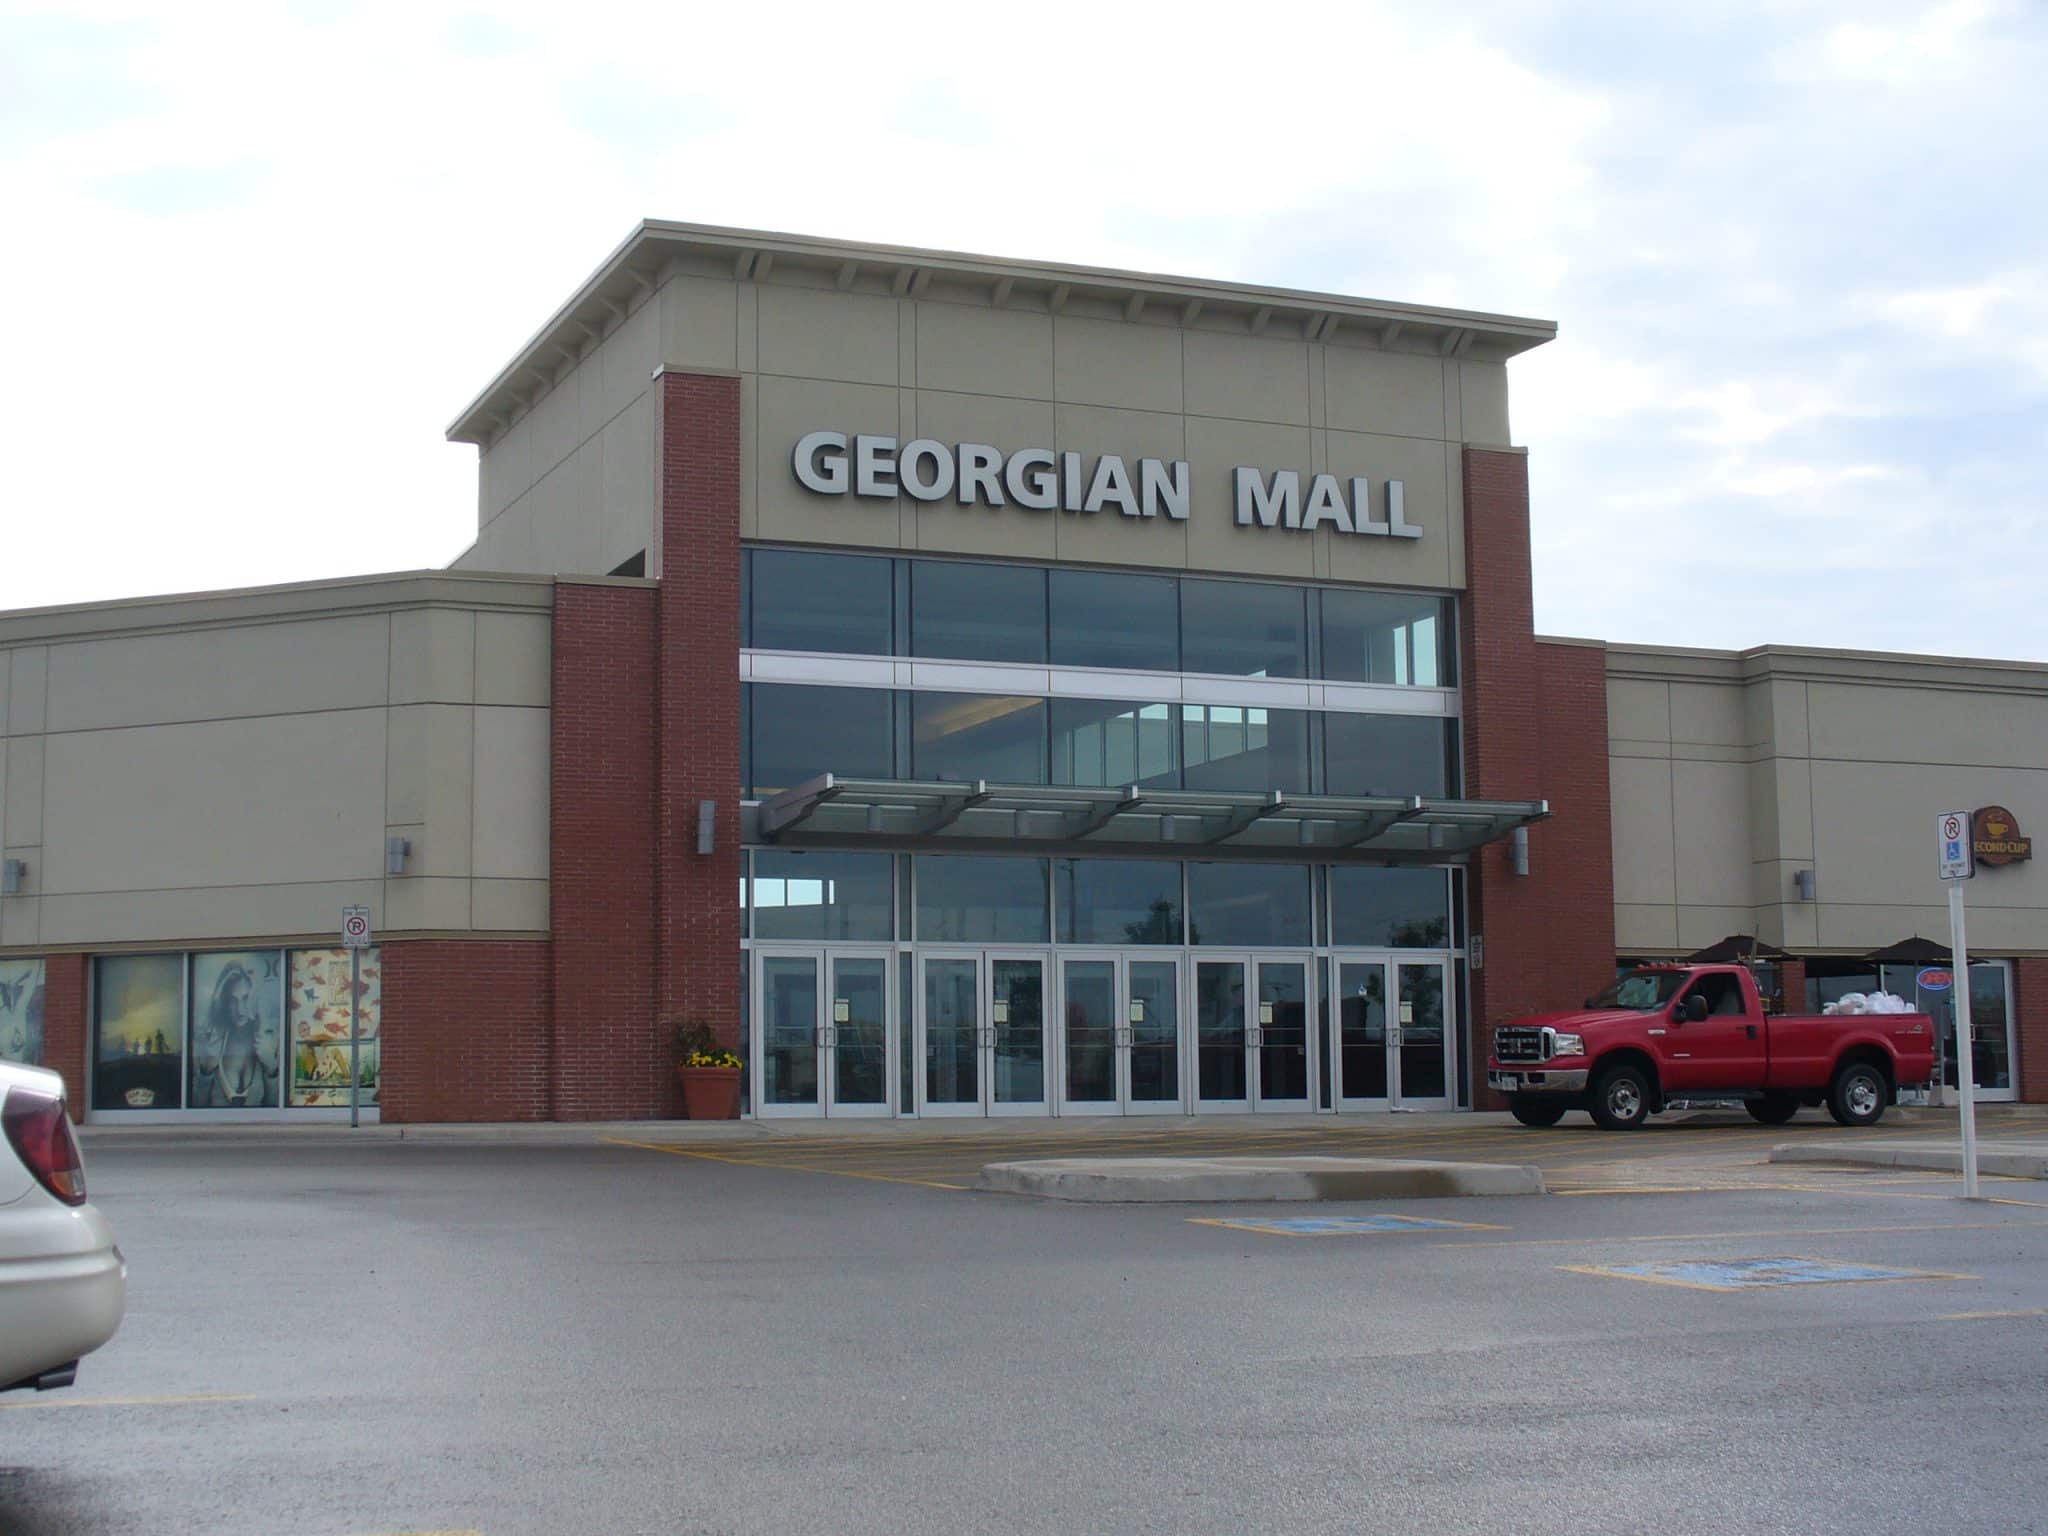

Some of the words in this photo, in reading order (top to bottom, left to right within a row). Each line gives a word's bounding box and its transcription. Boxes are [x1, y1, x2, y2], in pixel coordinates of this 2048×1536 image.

[793, 431, 1190, 520] GEORGIAN
[1232, 466, 1424, 539] MALL
[1974, 841, 2006, 853] ECOND
[1920, 971, 1952, 983] OPEN
